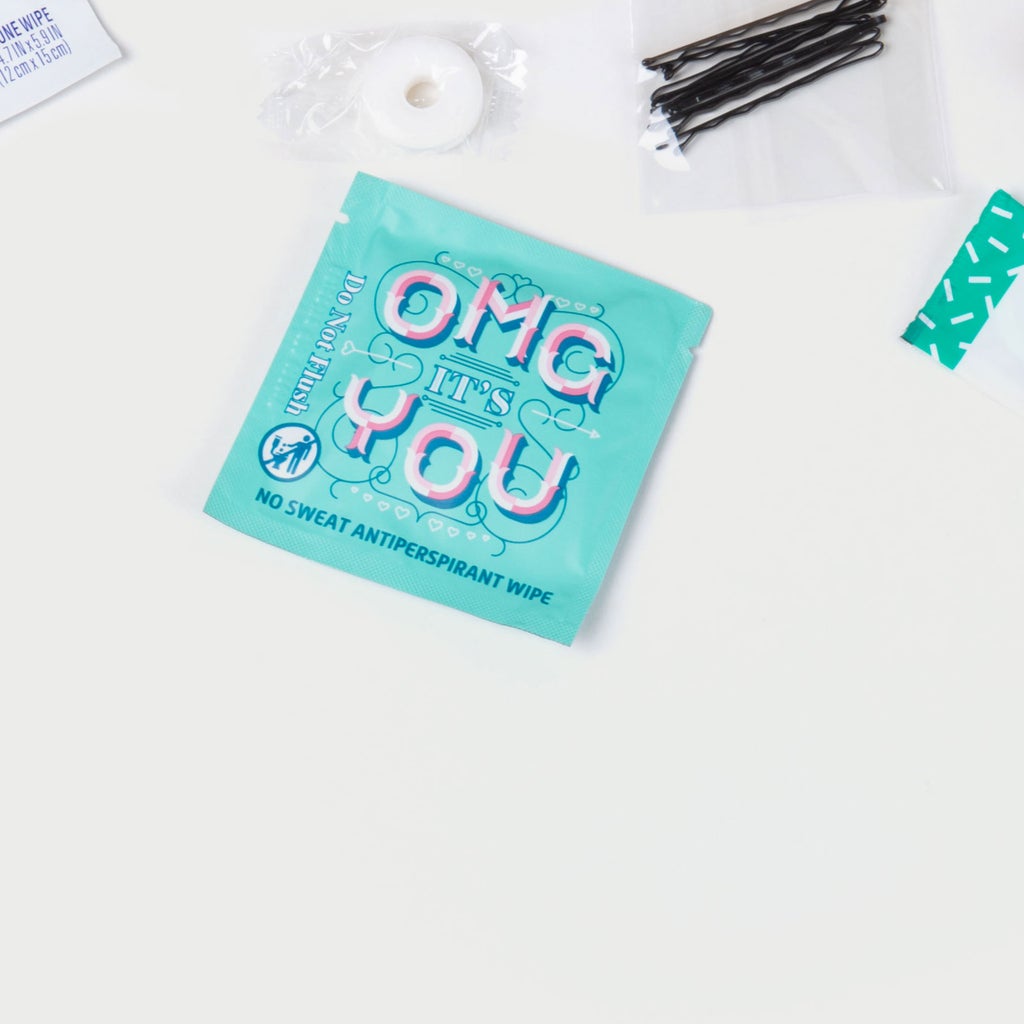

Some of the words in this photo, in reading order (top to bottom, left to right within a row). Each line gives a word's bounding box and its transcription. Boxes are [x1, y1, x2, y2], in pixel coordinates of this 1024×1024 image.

[18, 6, 53, 32] WIPE
[334, 269, 367, 309] Do
[314, 305, 352, 355] Not
[384, 269, 616, 414] OMG
[283, 350, 331, 421] Flush
[344, 374, 579, 524] YOU
[253, 486, 285, 511] NO
[284, 497, 352, 535] SWEAT
[350, 520, 506, 591] ANTIPERSPIRANT
[505, 576, 554, 606] WIPE
